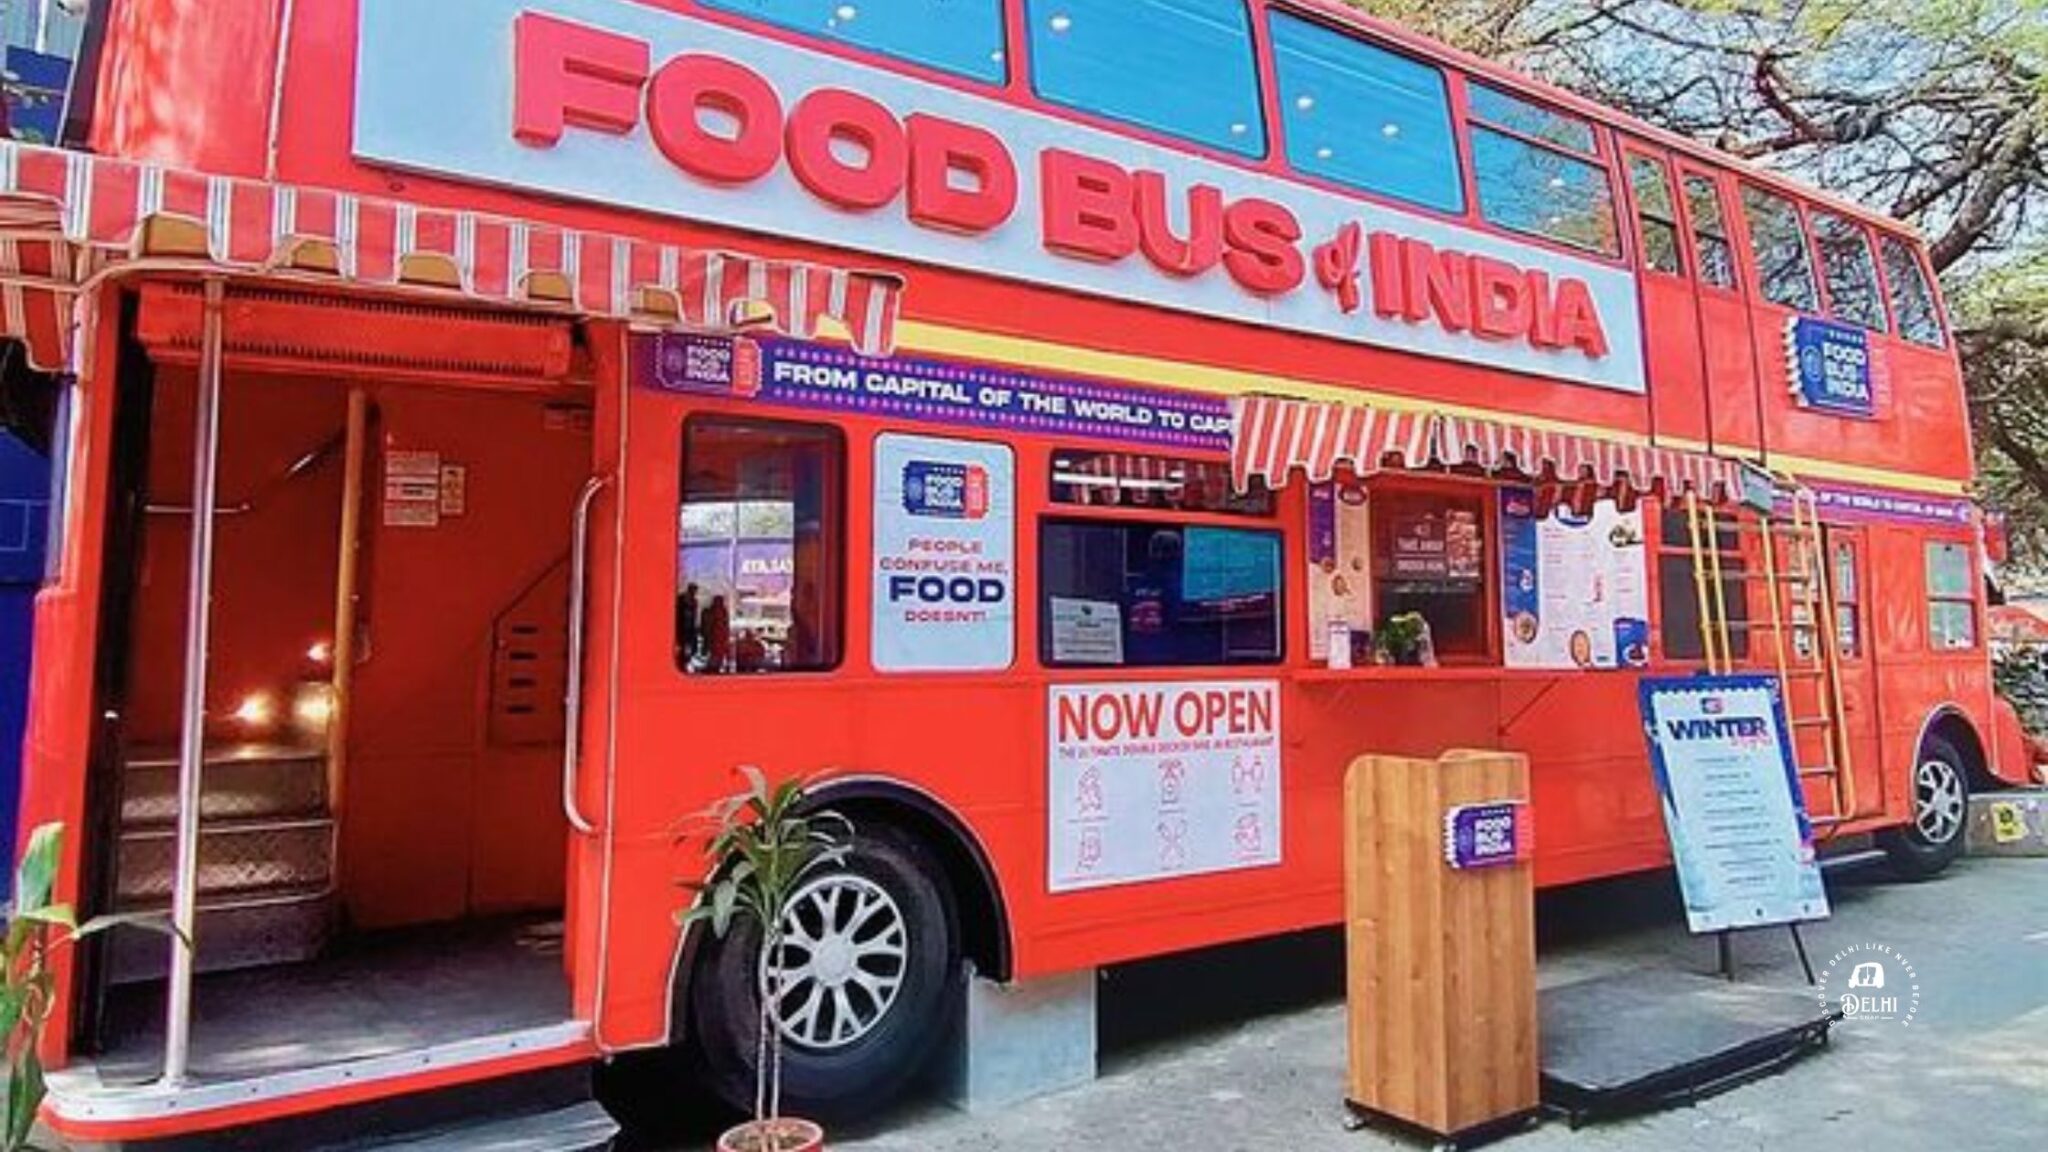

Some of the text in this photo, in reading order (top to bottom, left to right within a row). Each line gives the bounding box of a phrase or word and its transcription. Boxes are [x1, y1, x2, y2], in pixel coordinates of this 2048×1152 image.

[513, 11, 1609, 360] FOOD BUS of INDIA
[687, 345, 731, 361] FOOD
[1823, 342, 1866, 365] FOOD
[773, 361, 858, 389] FROM
[865, 373, 972, 404] CAPITAL
[979, 386, 1012, 408] OF
[1018, 392, 1066, 415] THE
[1072, 399, 1152, 425] WORLD
[1157, 410, 1184, 429] TO
[1826, 379, 1869, 400] INDIA
[925, 473, 964, 487] FOOD
[908, 538, 983, 554] PEOPLE
[880, 557, 1008, 576] CONFUSE ME,
[889, 576, 1005, 602] FOOD
[1058, 689, 1272, 742] NOW OPEN
[1666, 716, 1768, 740] WINTER
[1474, 816, 1511, 831] FOOD
[1474, 842, 1511, 856] INDIA
